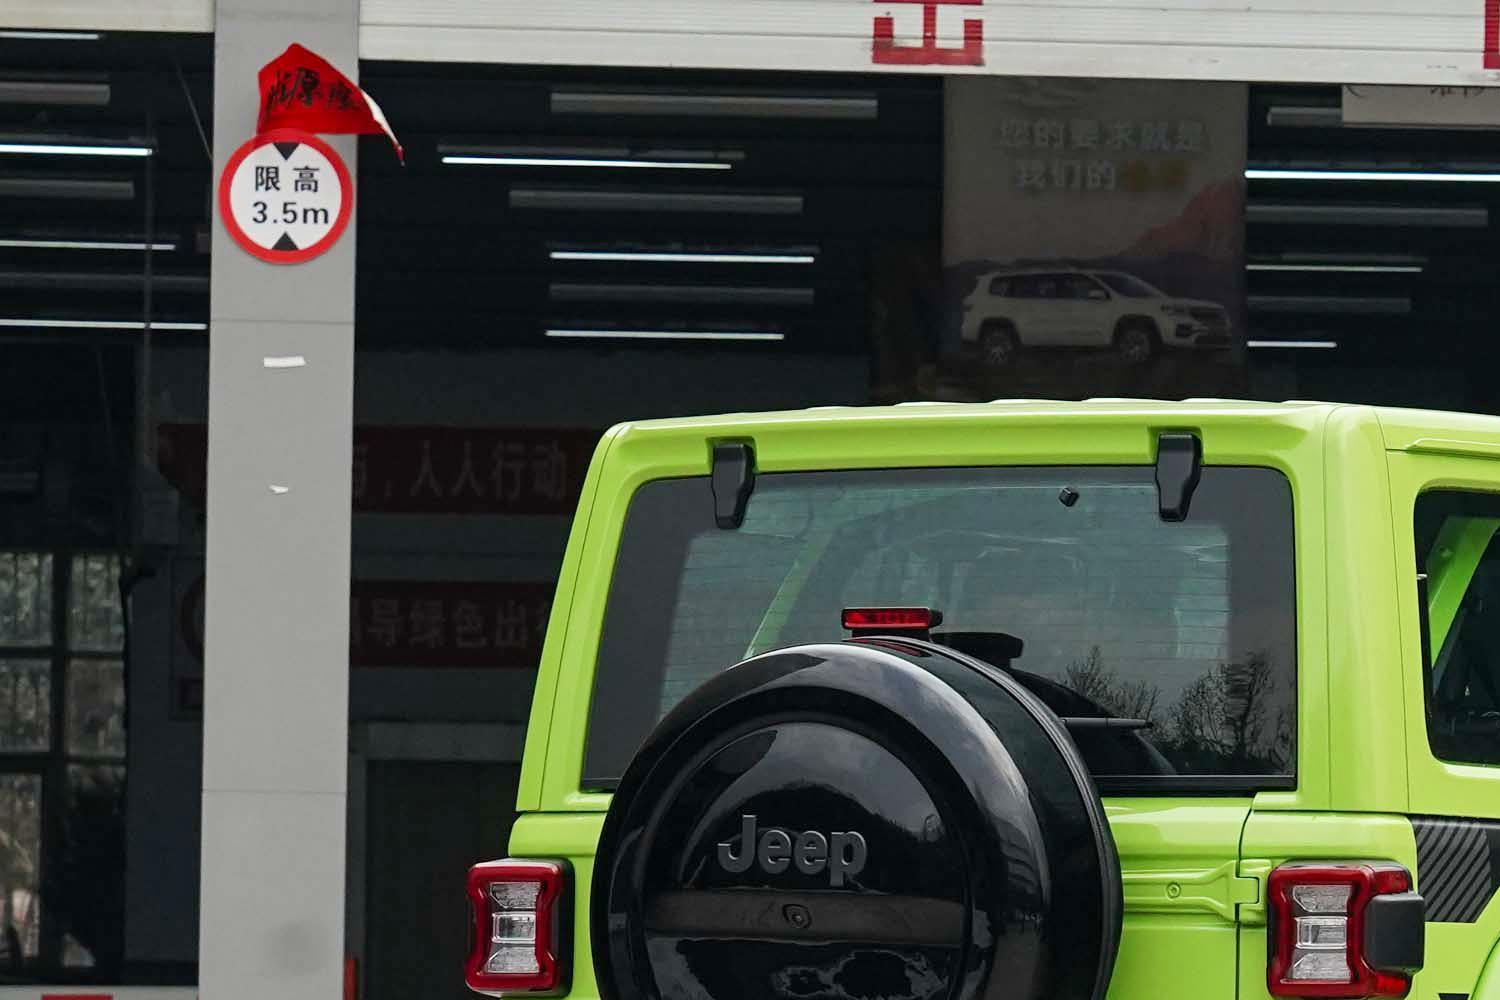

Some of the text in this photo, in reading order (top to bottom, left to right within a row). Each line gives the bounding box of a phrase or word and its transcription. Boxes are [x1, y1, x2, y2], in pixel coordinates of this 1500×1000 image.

[255, 166, 320, 192] 限高
[252, 201, 329, 224] 3.5m
[351, 597, 547, 649] 导绿色出
[717, 814, 868, 887] Jeep
